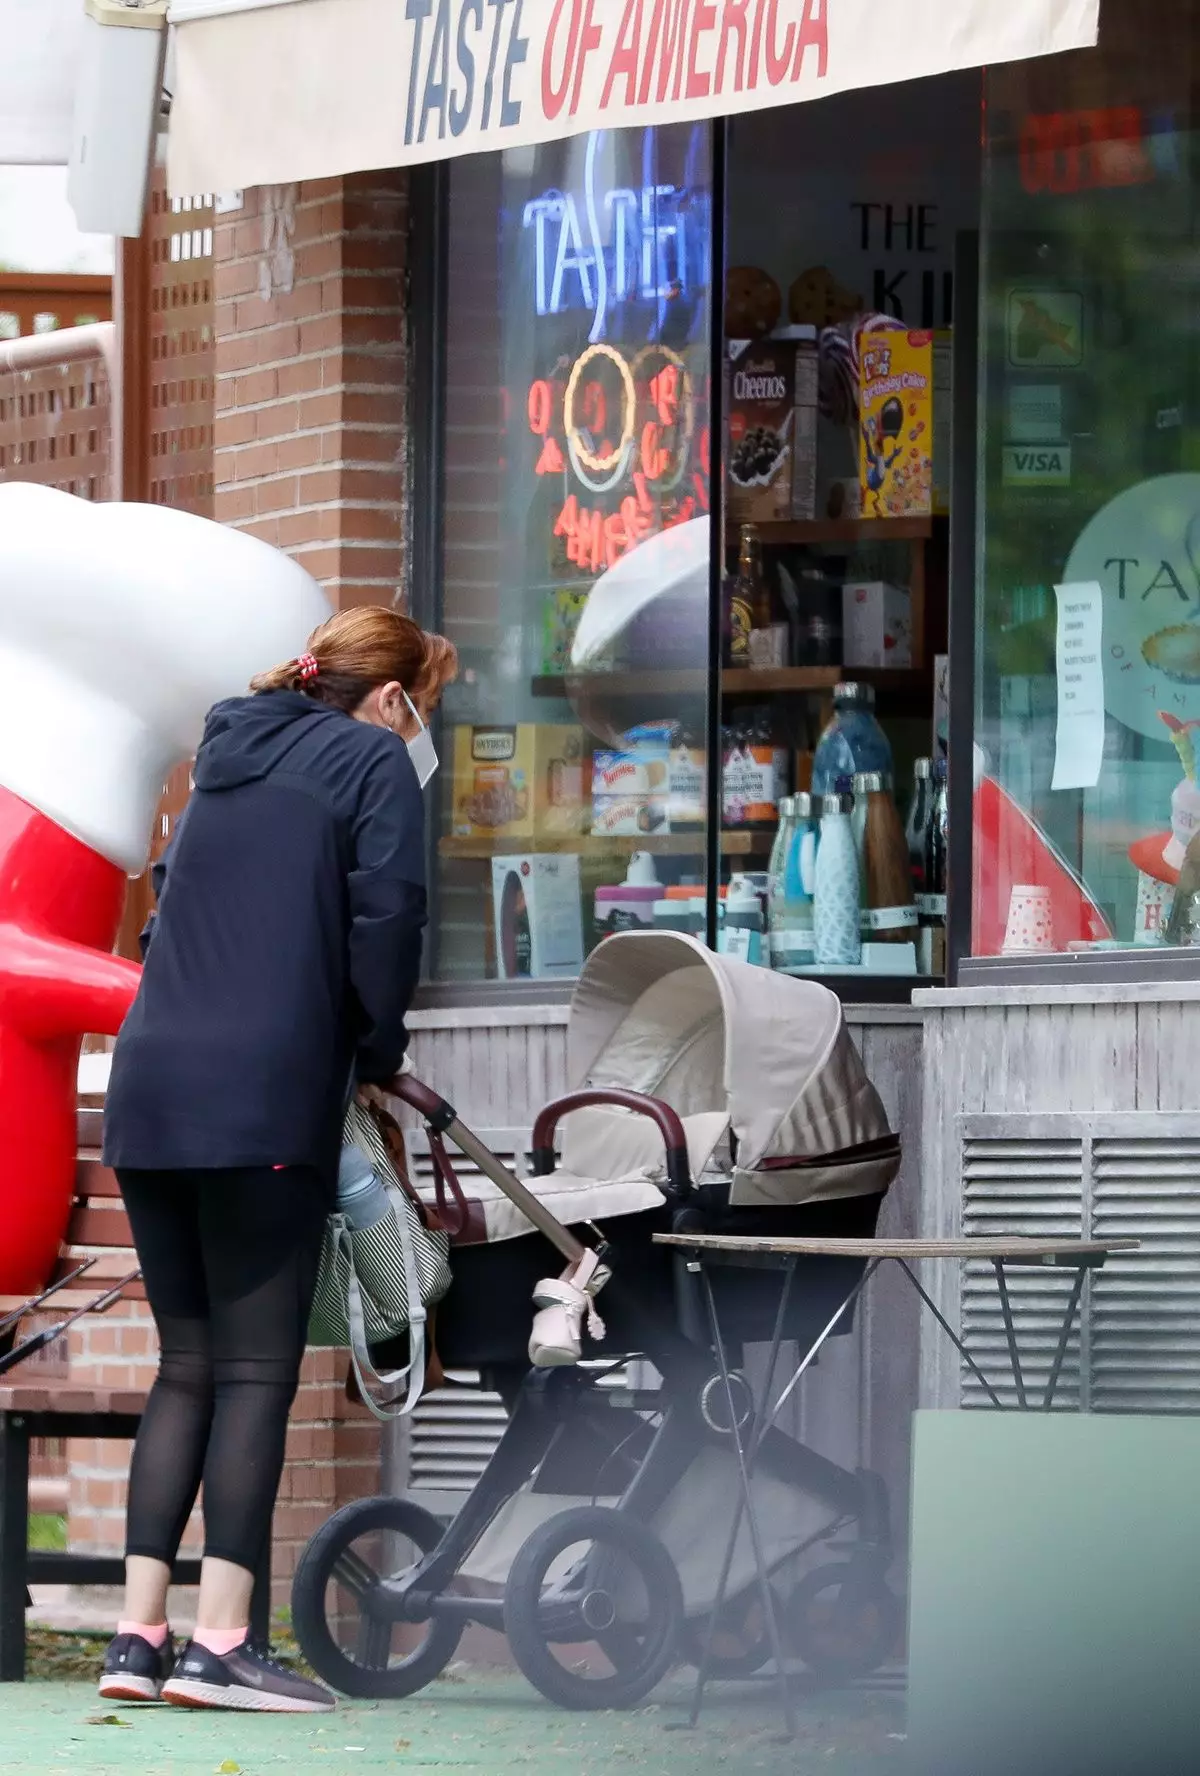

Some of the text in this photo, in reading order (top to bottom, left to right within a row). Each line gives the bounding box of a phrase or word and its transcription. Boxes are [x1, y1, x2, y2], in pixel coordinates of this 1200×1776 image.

[403, 0, 829, 146] TASTE OF AMERICA
[850, 202, 938, 253] THE
[873, 269, 954, 329] KI
[1012, 452, 1063, 473] VISA
[1103, 557, 1200, 603] TA
